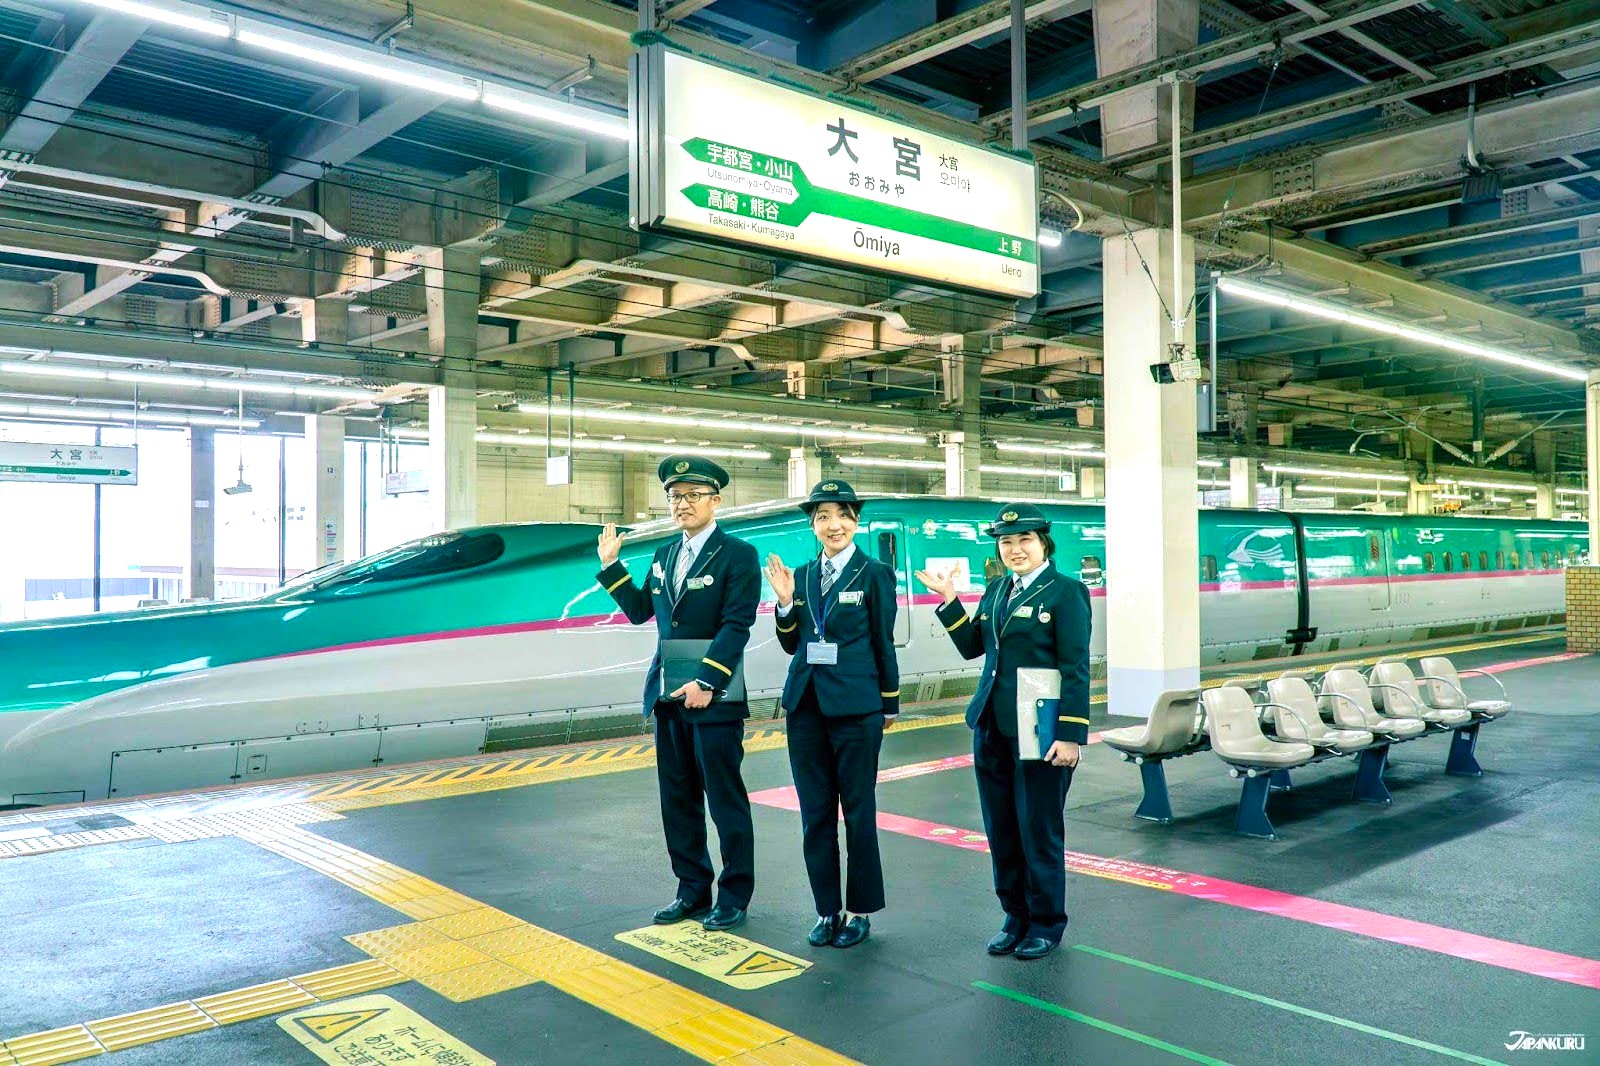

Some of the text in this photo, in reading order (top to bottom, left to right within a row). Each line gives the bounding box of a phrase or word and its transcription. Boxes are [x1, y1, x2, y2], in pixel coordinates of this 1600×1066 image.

[707, 144, 793, 180] 宇都宮・小山
[826, 117, 921, 182] 大宮
[848, 171, 905, 198] おおみや
[707, 189, 779, 221] 高崎・熊谷
[998, 236, 1022, 257] 上野
[1001, 263, 1022, 278] Ueno
